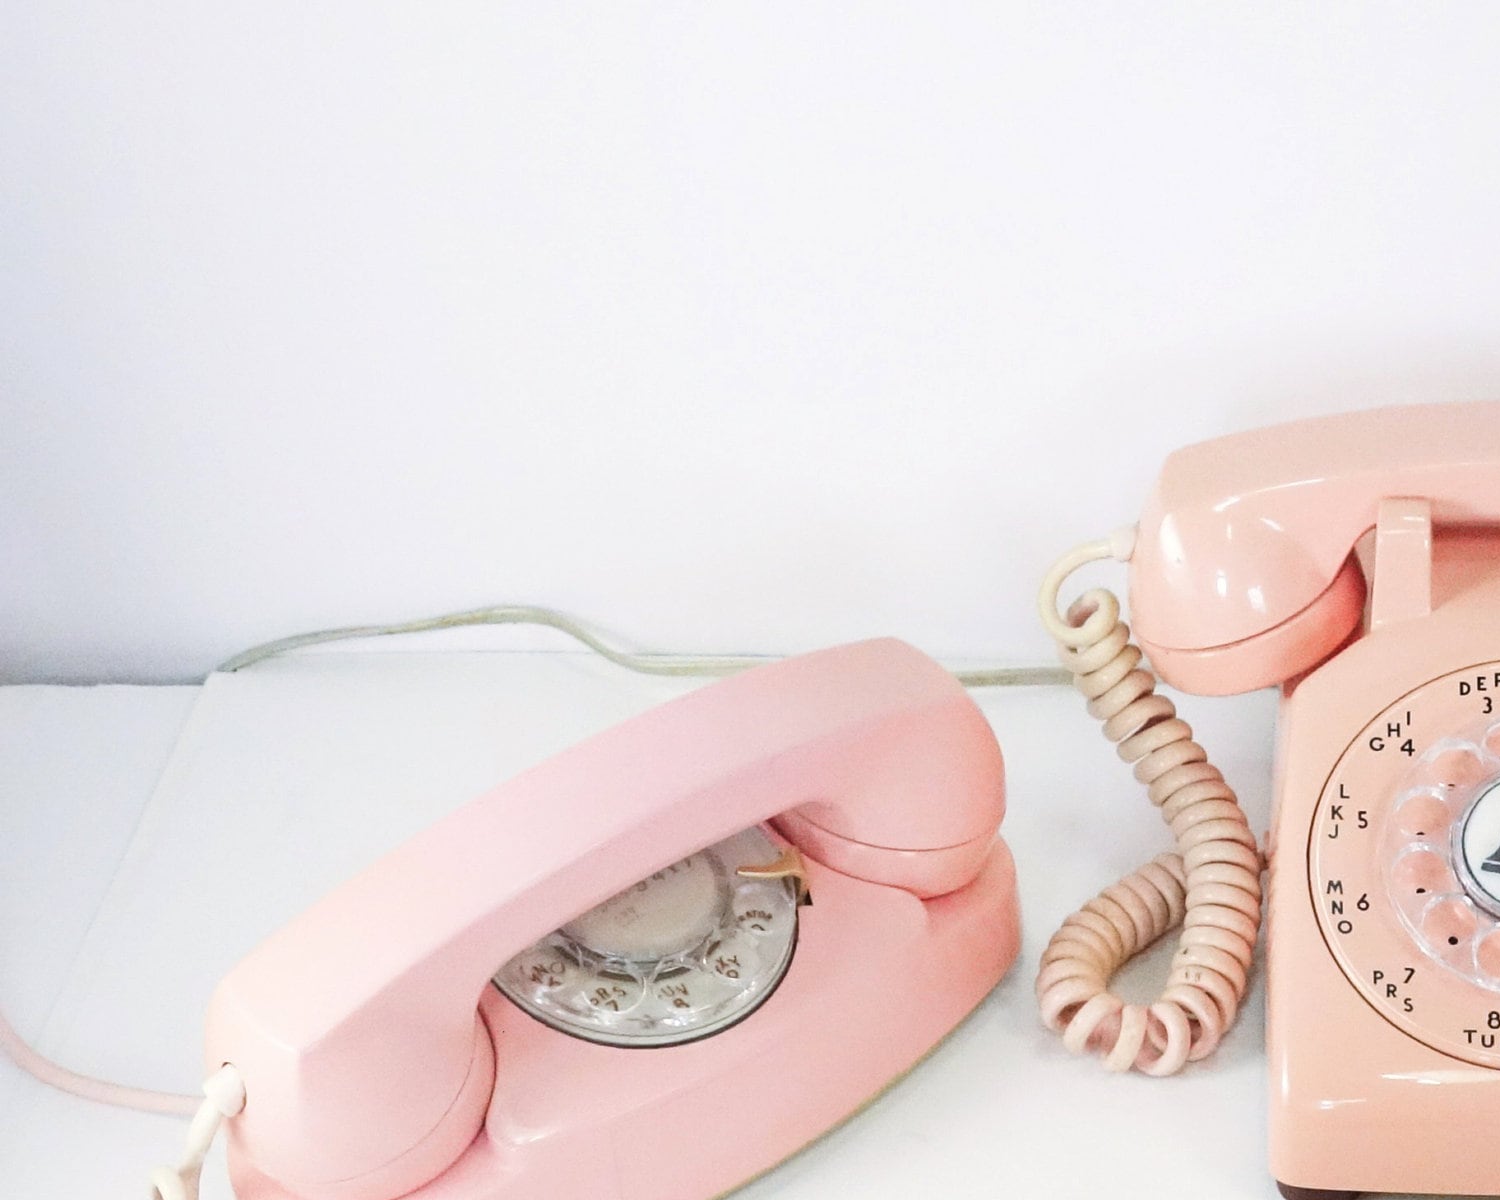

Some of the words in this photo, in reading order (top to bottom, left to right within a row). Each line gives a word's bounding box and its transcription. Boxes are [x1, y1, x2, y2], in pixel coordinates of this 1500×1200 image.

[1482, 697, 1493, 714] 3
[1400, 738, 1416, 757] 4
[1358, 810, 1369, 829] 5
[1357, 893, 1370, 911] 6
[1403, 967, 1416, 984] 7
